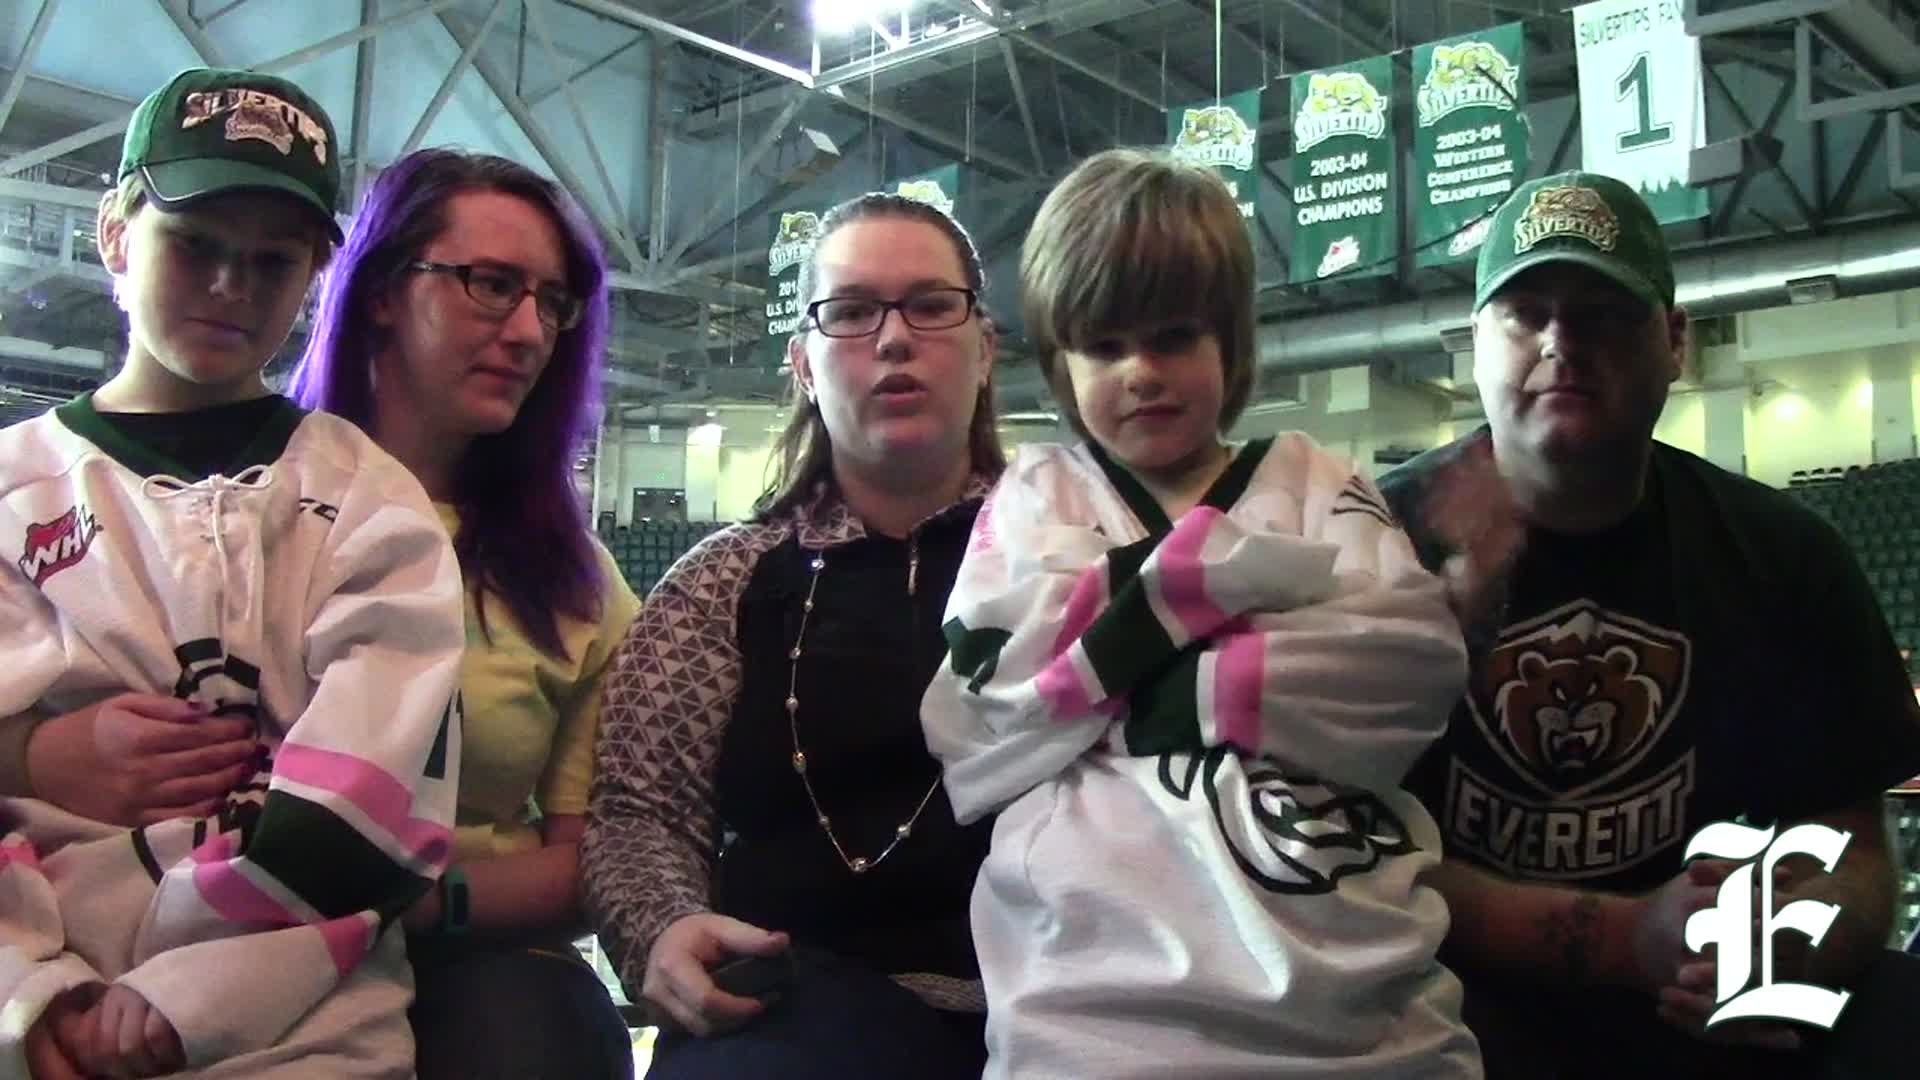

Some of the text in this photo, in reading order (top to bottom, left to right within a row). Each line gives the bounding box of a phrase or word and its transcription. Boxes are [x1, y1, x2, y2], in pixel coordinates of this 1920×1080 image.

[1615, 50, 1675, 154] 1
[1436, 124, 1502, 150] 2003-04
[1310, 151, 1368, 177] 2003-04
[1433, 143, 1505, 168] WESTERN
[1321, 172, 1388, 200] DIVISION
[1427, 160, 1514, 188] CONFERENCE
[1430, 179, 1512, 205] CHAMPIONS
[1297, 195, 1383, 226] CHAMPIONS
[1514, 215, 1619, 254] SILVERTIPS
[1455, 774, 1684, 869] EVERETT
